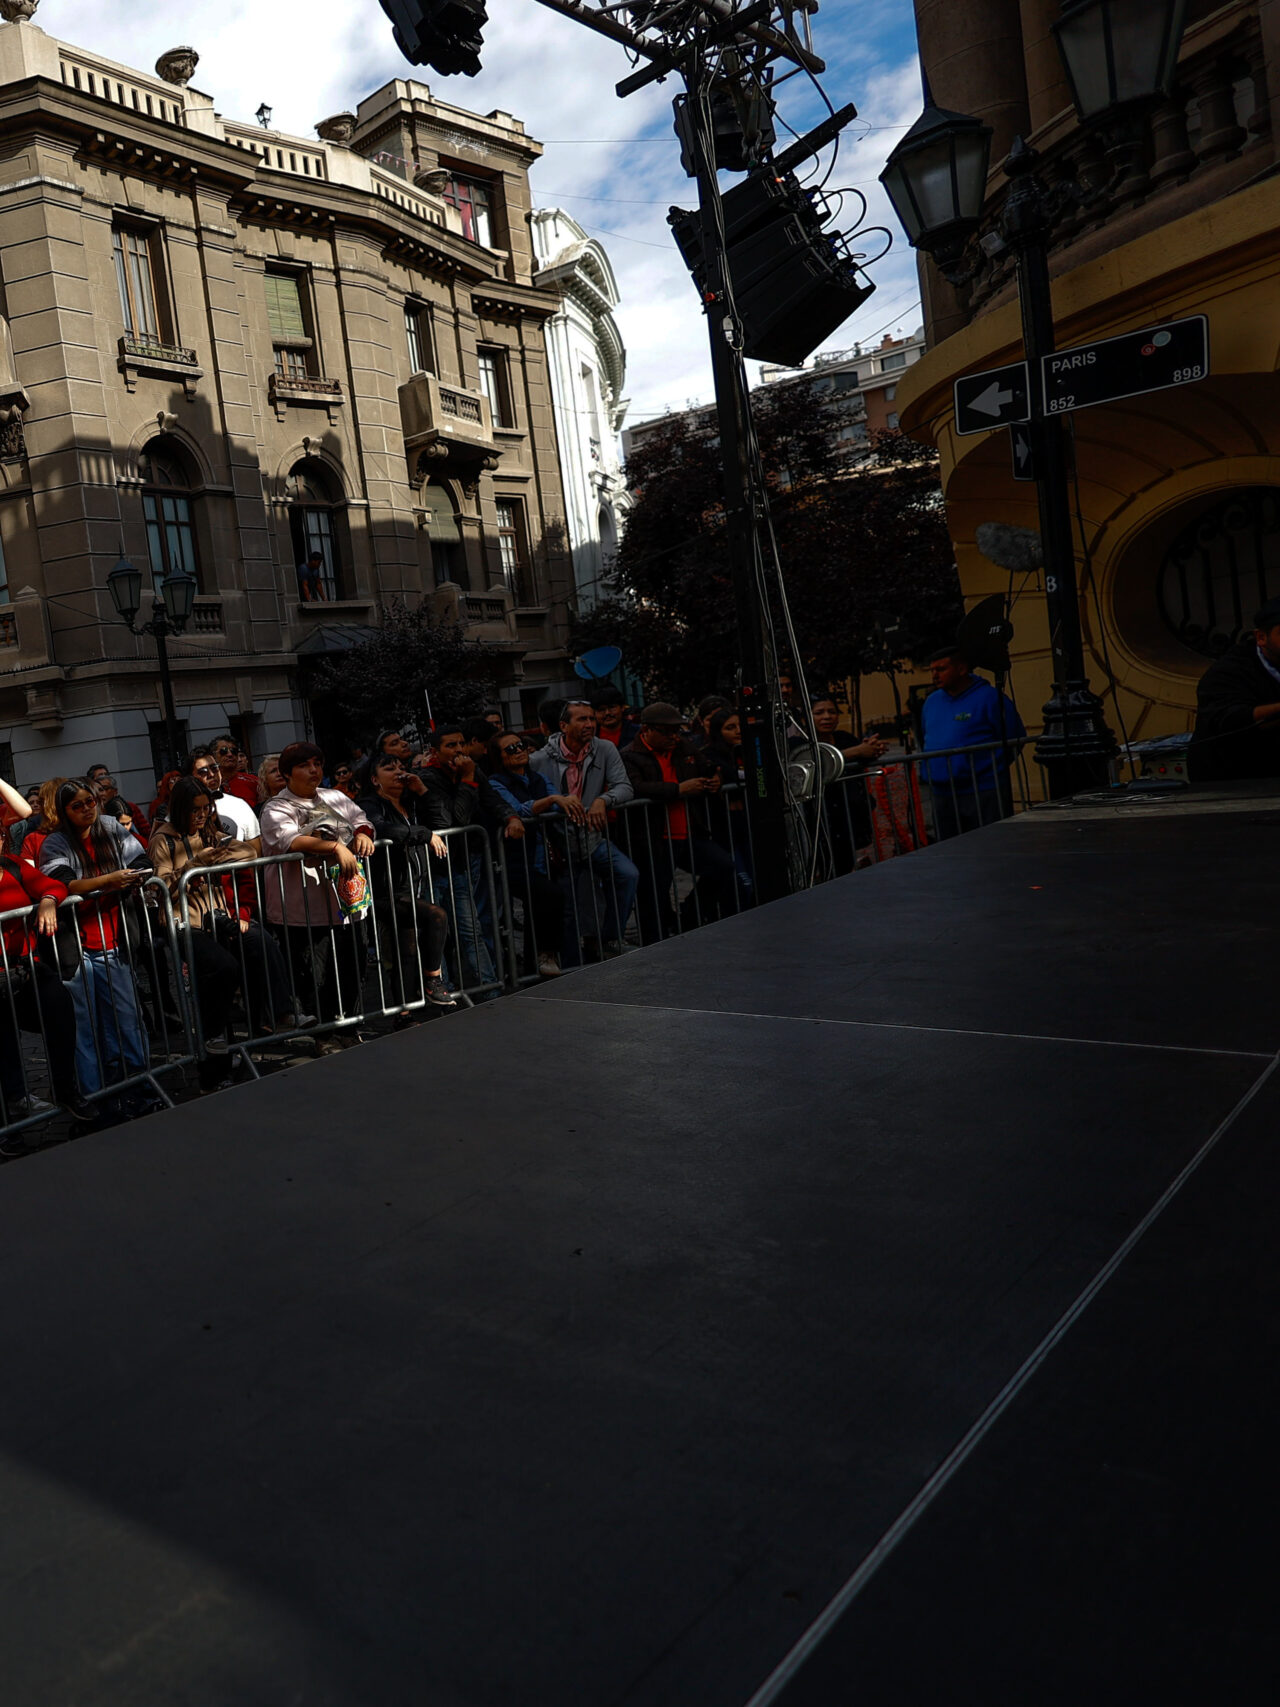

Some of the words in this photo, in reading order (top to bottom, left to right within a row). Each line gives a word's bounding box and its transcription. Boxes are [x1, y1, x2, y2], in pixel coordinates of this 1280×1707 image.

[1051, 352, 1097, 374] PARIS
[1172, 365, 1202, 383] 898
[1049, 395, 1076, 412] 852
